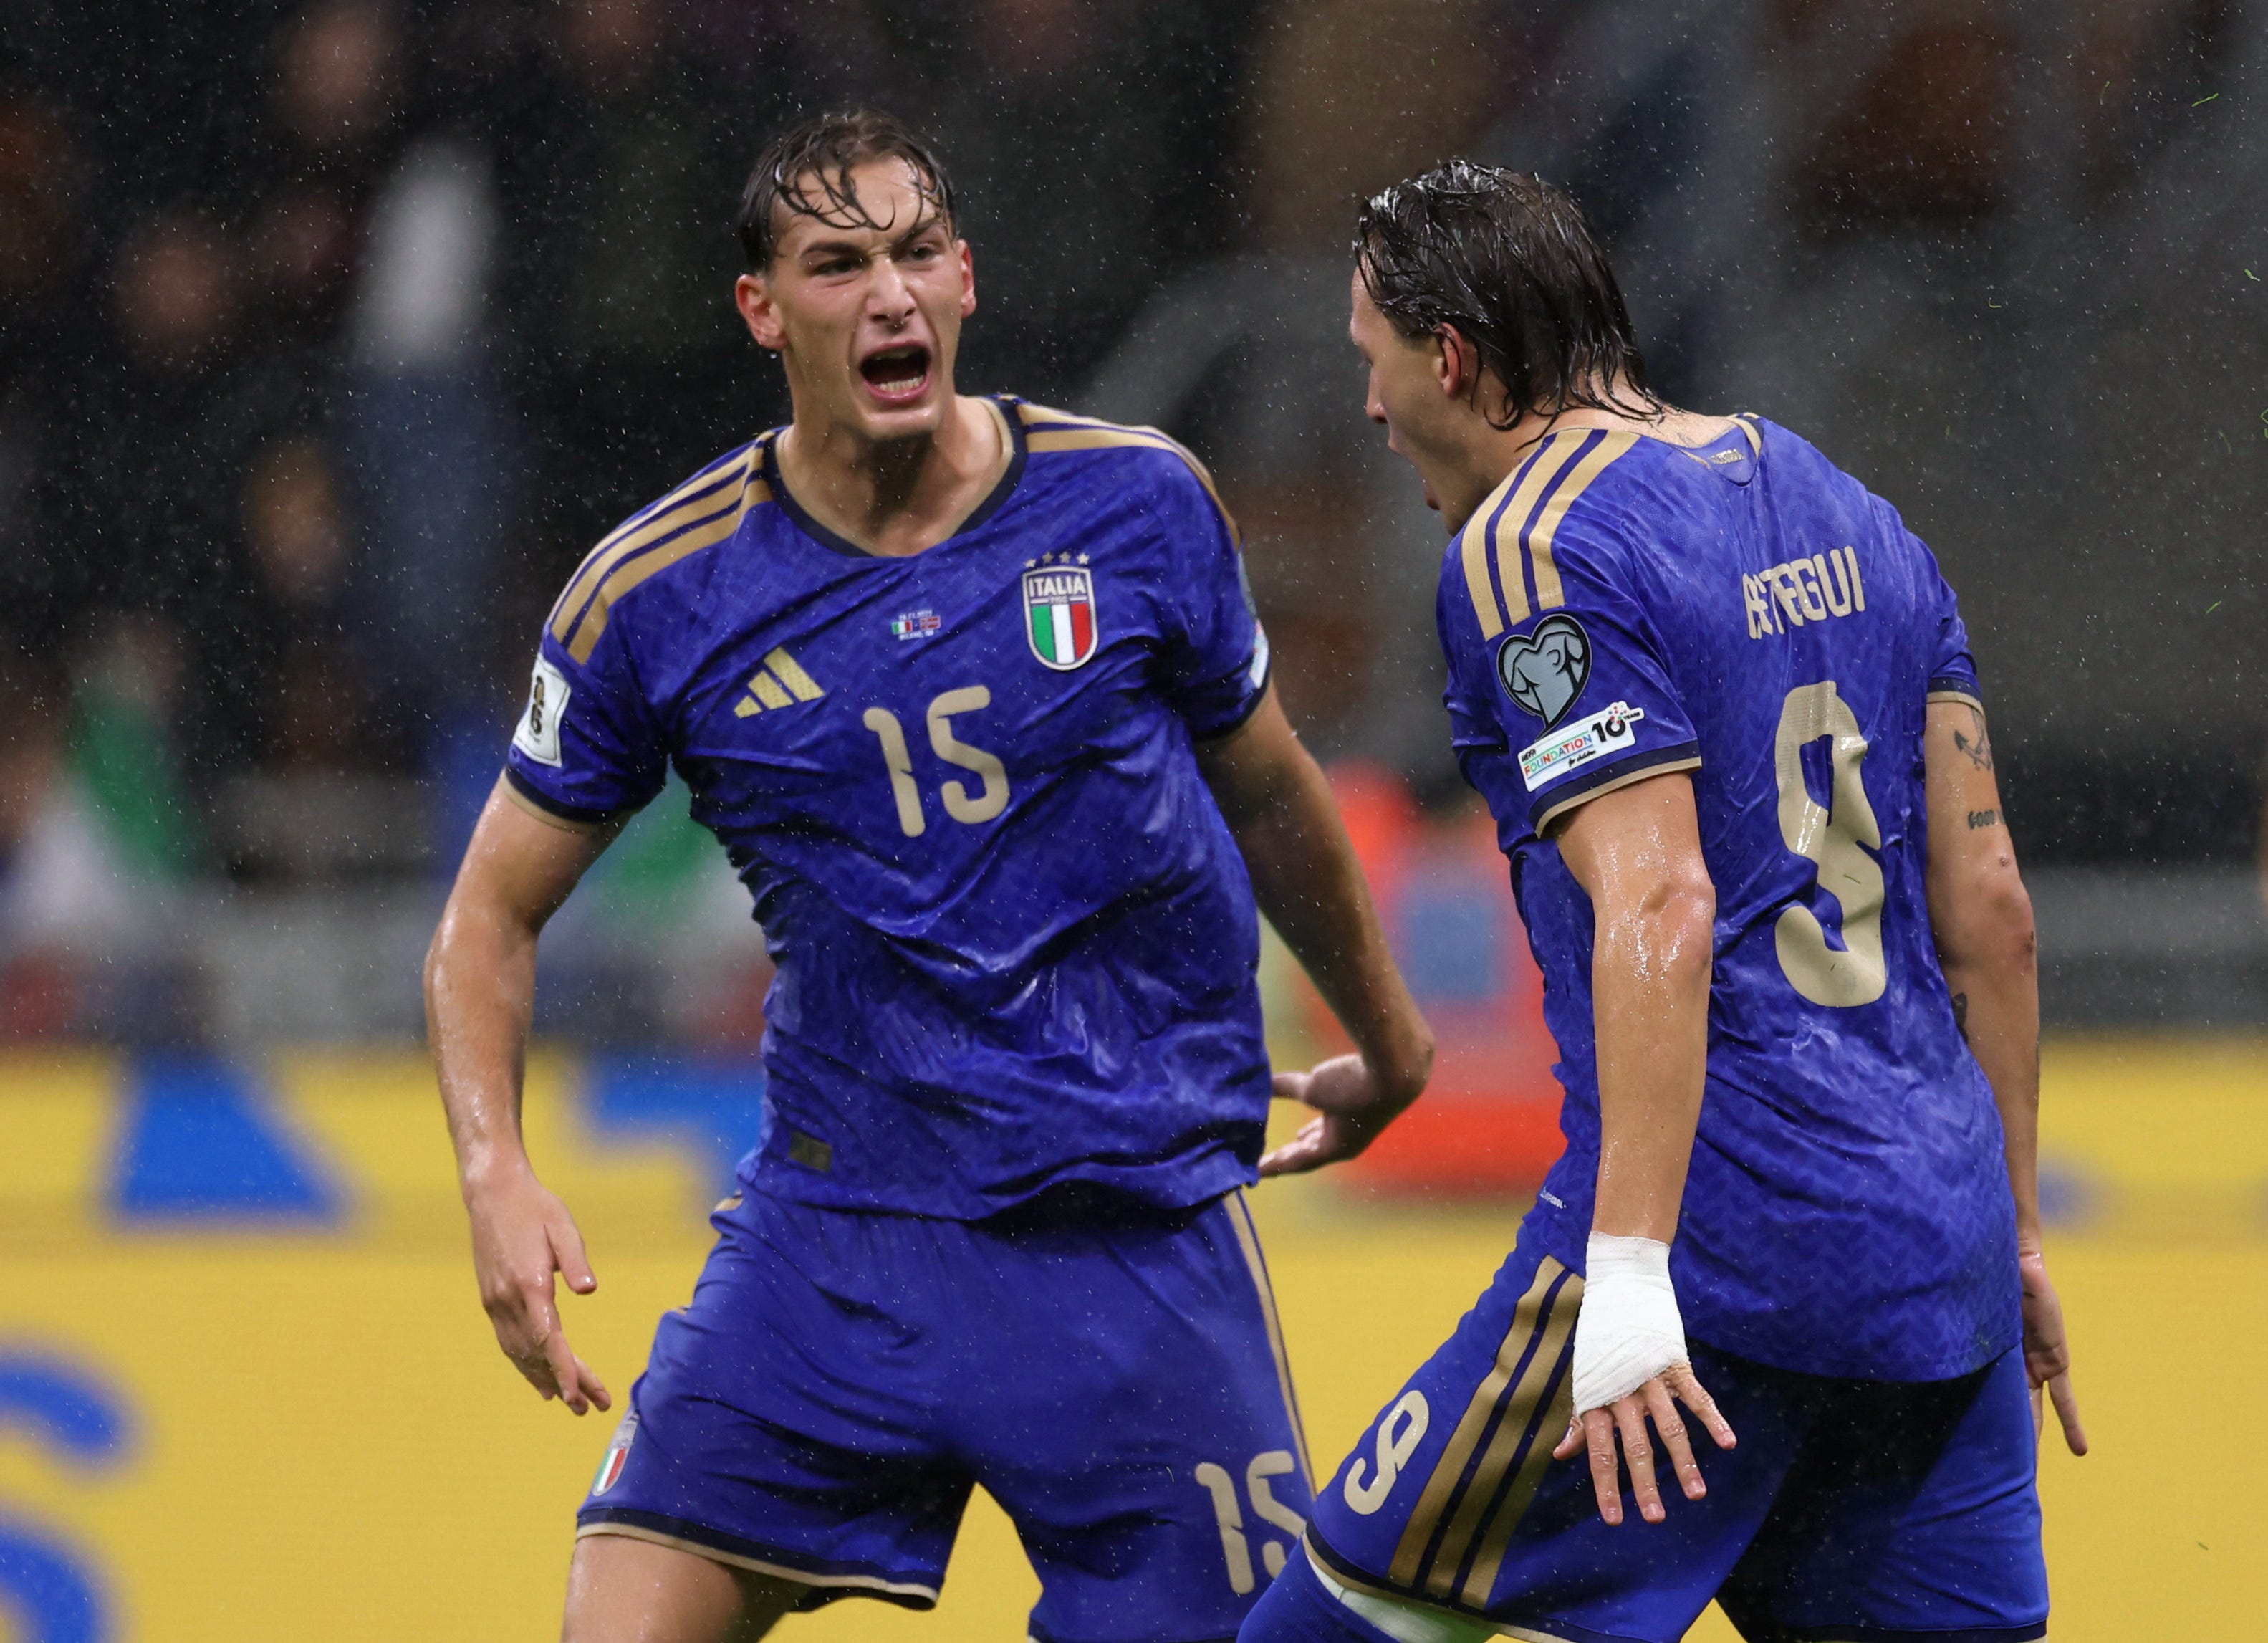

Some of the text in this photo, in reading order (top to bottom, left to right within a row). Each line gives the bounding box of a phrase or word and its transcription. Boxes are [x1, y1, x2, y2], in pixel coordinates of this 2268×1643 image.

[1029, 575, 1087, 597] ITALIA
[863, 685, 1010, 837] 15
[1524, 734, 1592, 777] FOUNDATION
[1592, 718, 1625, 742] 10
[1774, 680, 1887, 1008] 9
[1344, 1390, 1429, 1515] 9
[1195, 1450, 1307, 1594] 15
